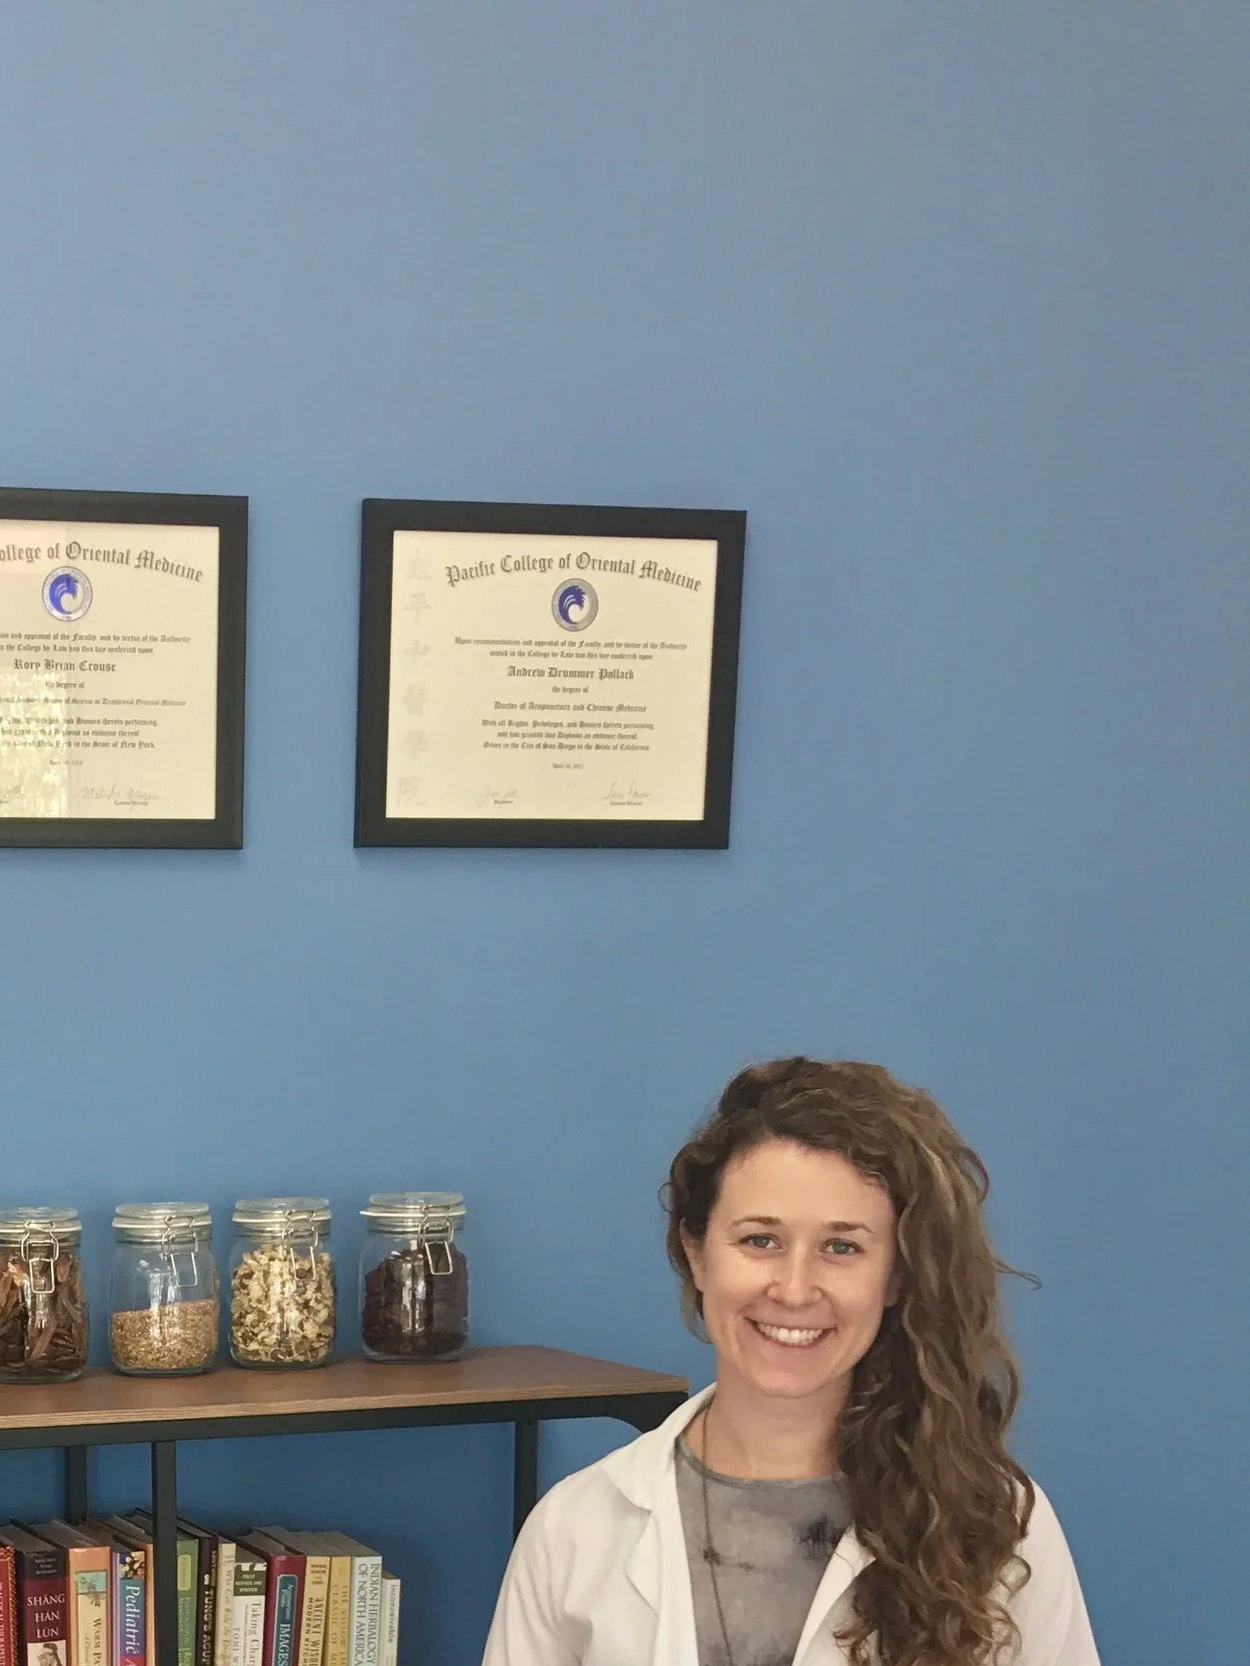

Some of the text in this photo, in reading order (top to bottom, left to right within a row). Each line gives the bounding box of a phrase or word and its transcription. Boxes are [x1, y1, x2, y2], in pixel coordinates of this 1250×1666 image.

[47, 543, 60, 560] of
[65, 541, 130, 566] Oriental
[134, 550, 204, 583] Medicine
[445, 552, 701, 592] Pacific College of Oriental Medicine
[13, 658, 116, 672] Rory Brian Crouse
[507, 665, 634, 680] Andrew Drummer Pollack
[331, 1585, 339, 1627] CLASSIC
[341, 1585, 349, 1603] THE
[388, 1584, 398, 1643] inconceivable
[93, 1618, 103, 1649] WARM
[125, 1585, 141, 1655] Pediatric
[249, 1600, 261, 1637] Taking
[305, 1597, 314, 1636] MODERN
[311, 1596, 324, 1634] ANCIENT
[340, 1611, 348, 1646] YELLOW
[354, 1564, 368, 1666] OF NORTH AMERICA
[366, 1563, 381, 1665] INDIAN HERBALOGY
[277, 1623, 291, 1666] IMAGES
[331, 1632, 338, 1645] OF
